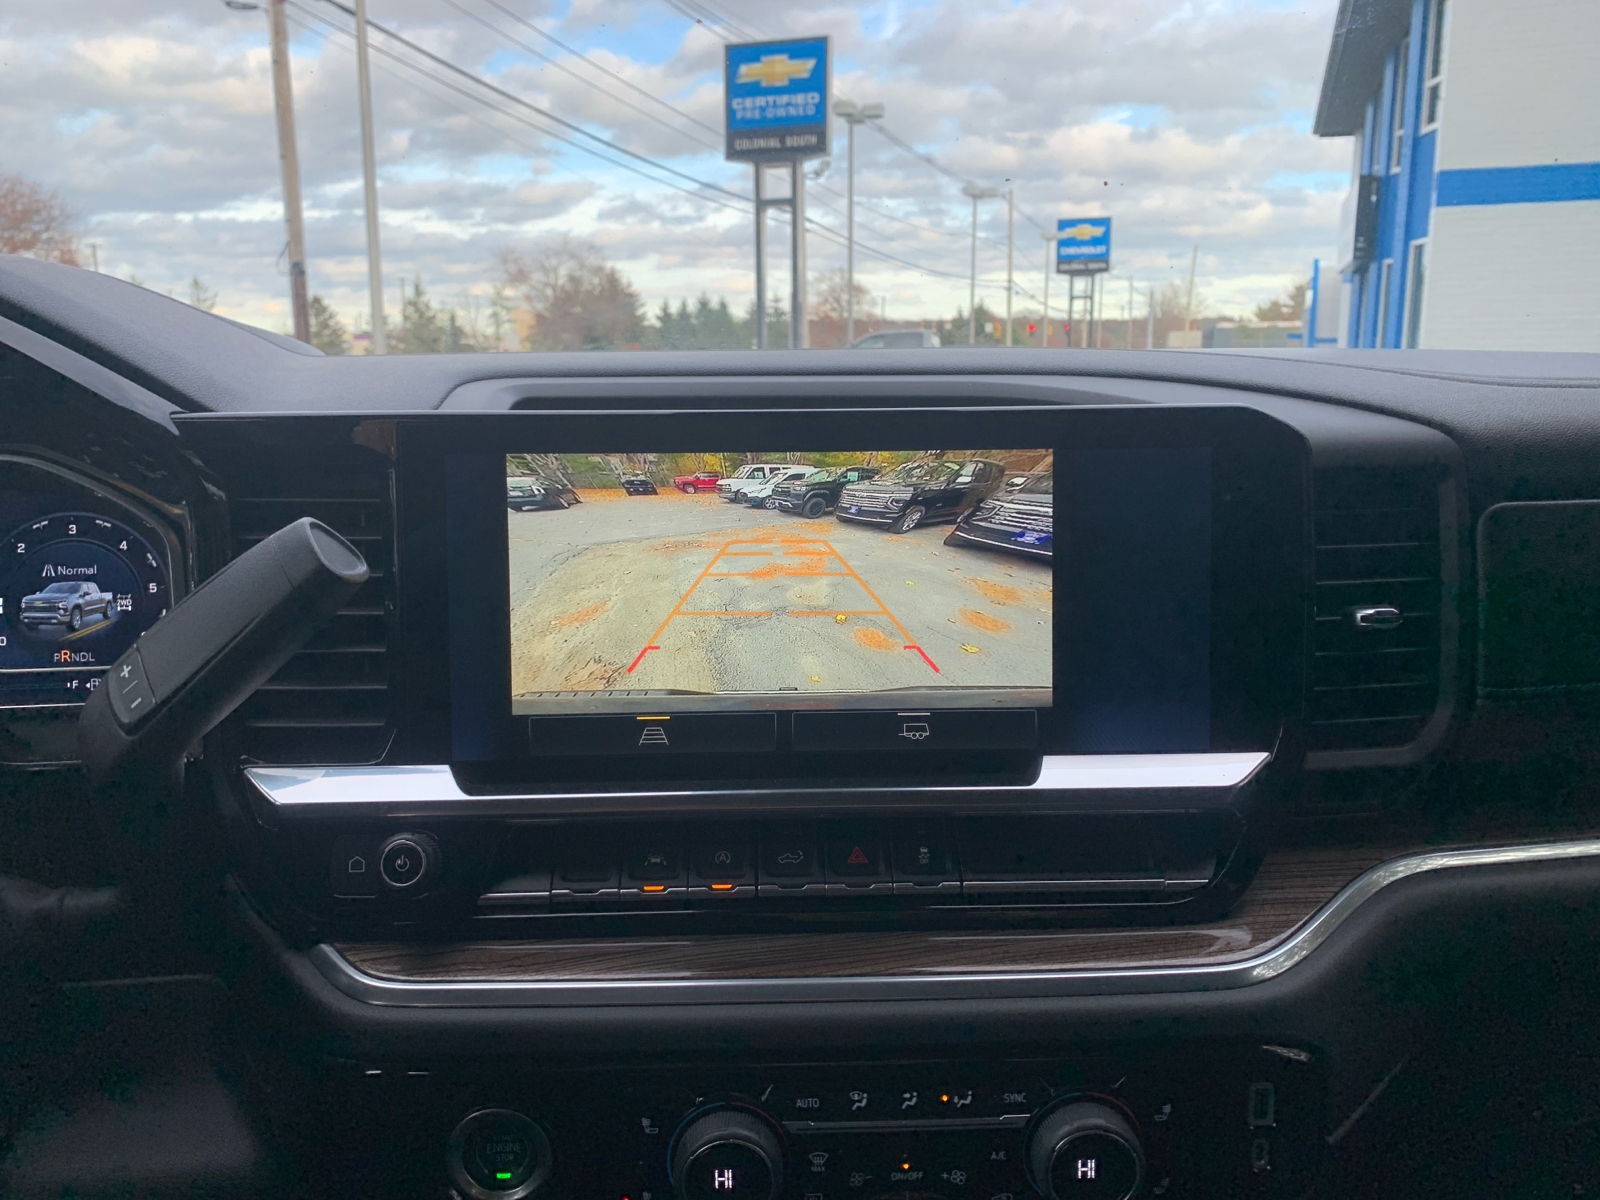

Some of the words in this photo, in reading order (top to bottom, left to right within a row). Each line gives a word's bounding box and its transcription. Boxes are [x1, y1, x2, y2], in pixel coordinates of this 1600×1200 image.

[731, 91, 820, 109] CERTIFIED
[734, 137, 781, 150] COLONIAL
[785, 134, 818, 147] SOUTH
[69, 524, 77, 535] 3
[17, 543, 26, 553] 2
[119, 540, 128, 551] 4
[57, 564, 98, 575] Normal
[149, 583, 157, 593] 5
[116, 599, 133, 607] 2WD
[72, 680, 79, 689] F
[796, 1097, 820, 1109] AUTO
[1003, 1092, 1027, 1103] SYNC
[486, 1141, 522, 1154] ENGINE
[495, 1153, 514, 1162] STOP
[990, 1151, 1007, 1161] A/C
[1077, 1159, 1096, 1179] HI
[714, 1169, 733, 1189] HI
[890, 1171, 924, 1181] ON/OFF
